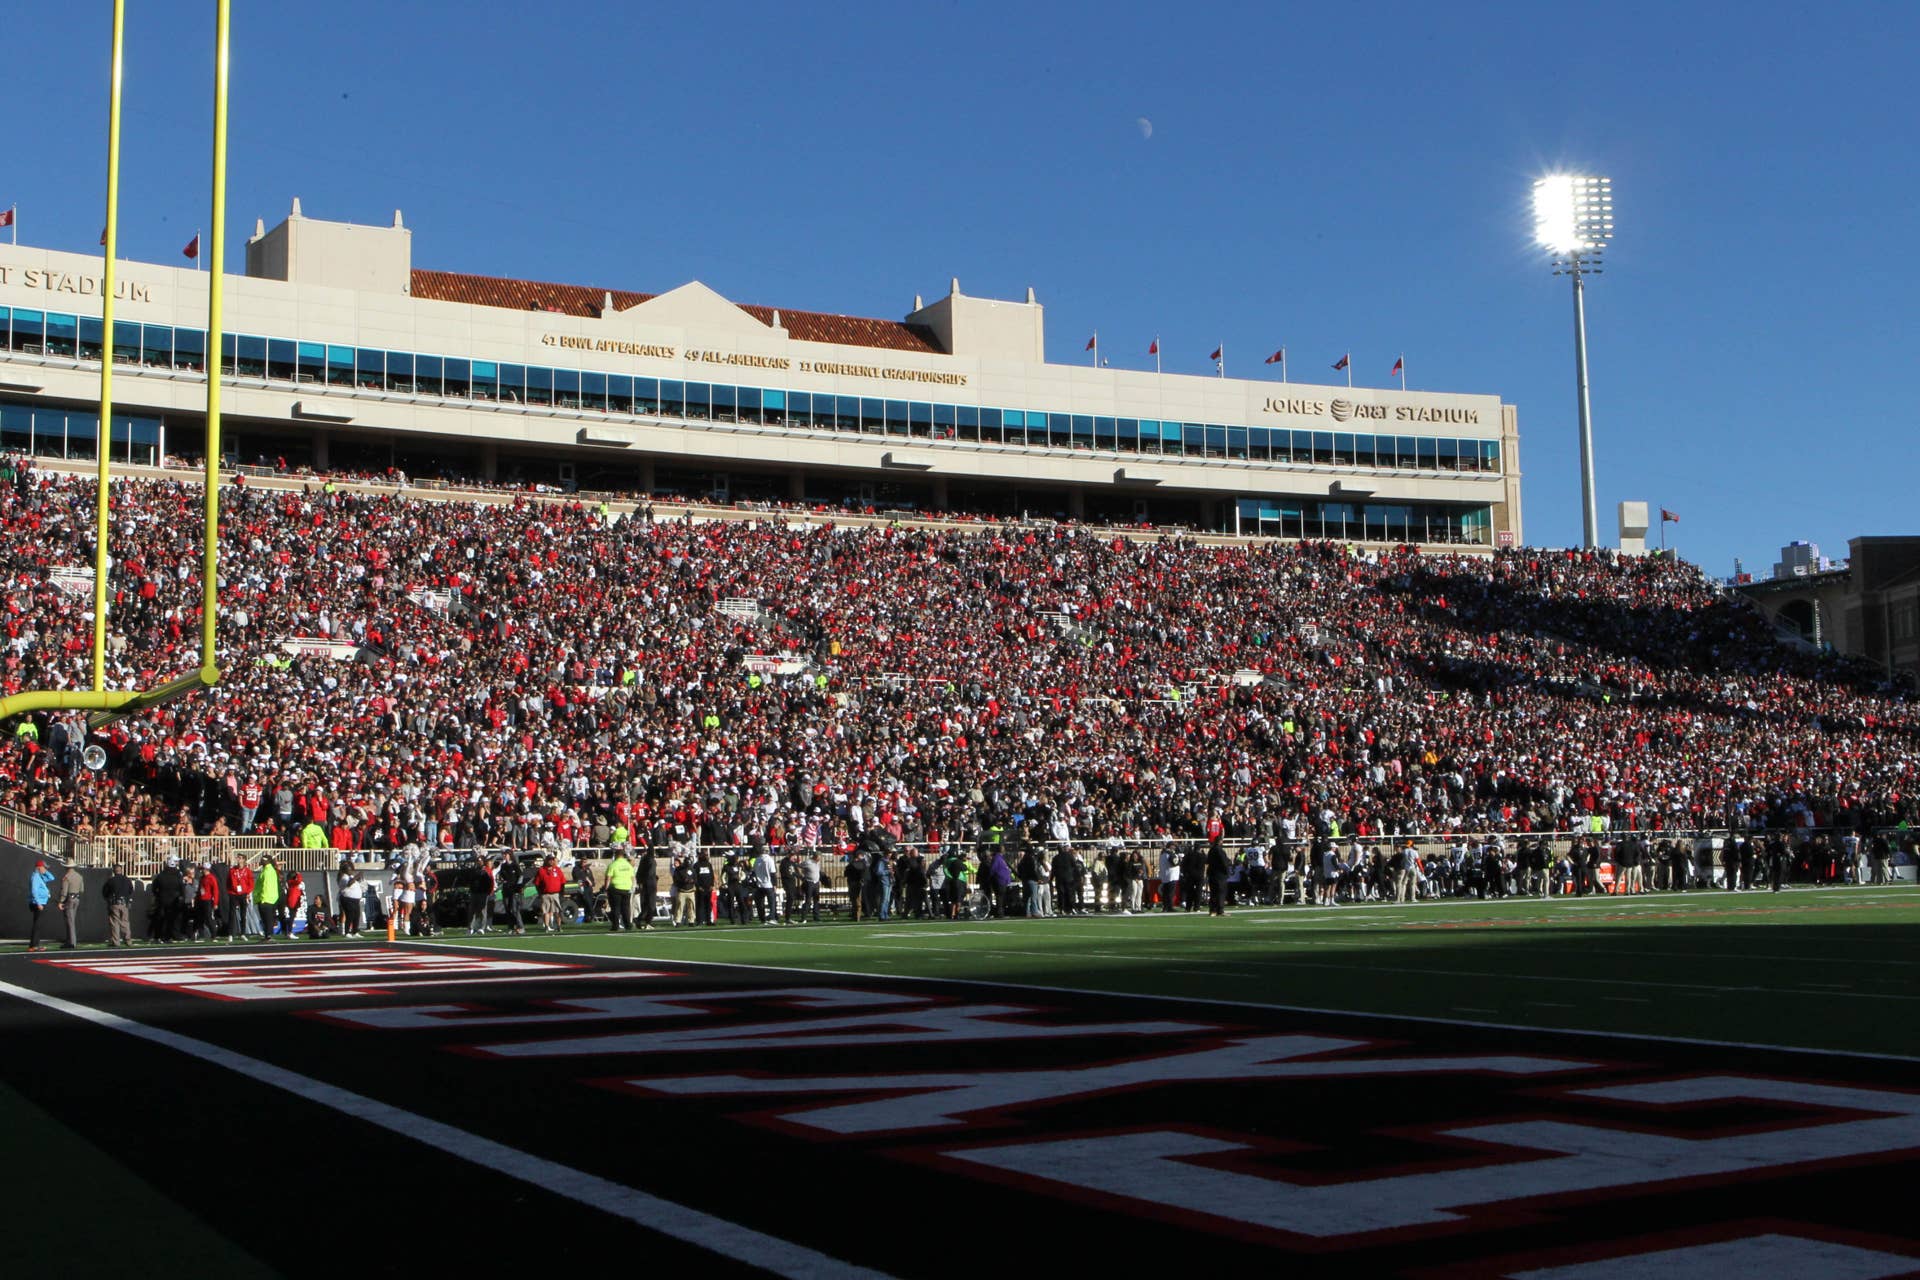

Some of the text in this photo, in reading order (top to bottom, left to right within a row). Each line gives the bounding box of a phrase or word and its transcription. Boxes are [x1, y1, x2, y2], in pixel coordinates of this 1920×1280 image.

[560, 335, 593, 350] BOWL
[596, 339, 676, 359] APPEARANCES
[684, 349, 699, 362] 49
[701, 350, 791, 370] ALL-AMERICANS
[799, 361, 812, 372] 11
[814, 361, 881, 379] CONFERENCE
[882, 367, 968, 386] CHAMPIONSHIPS
[1263, 397, 1479, 425] JONES AT&T STADIUM
[1500, 534, 1513, 542] 122
[246, 790, 257, 800] 23
[1247, 851, 1259, 862] 59
[300, 986, 1920, 1280] EXAS
